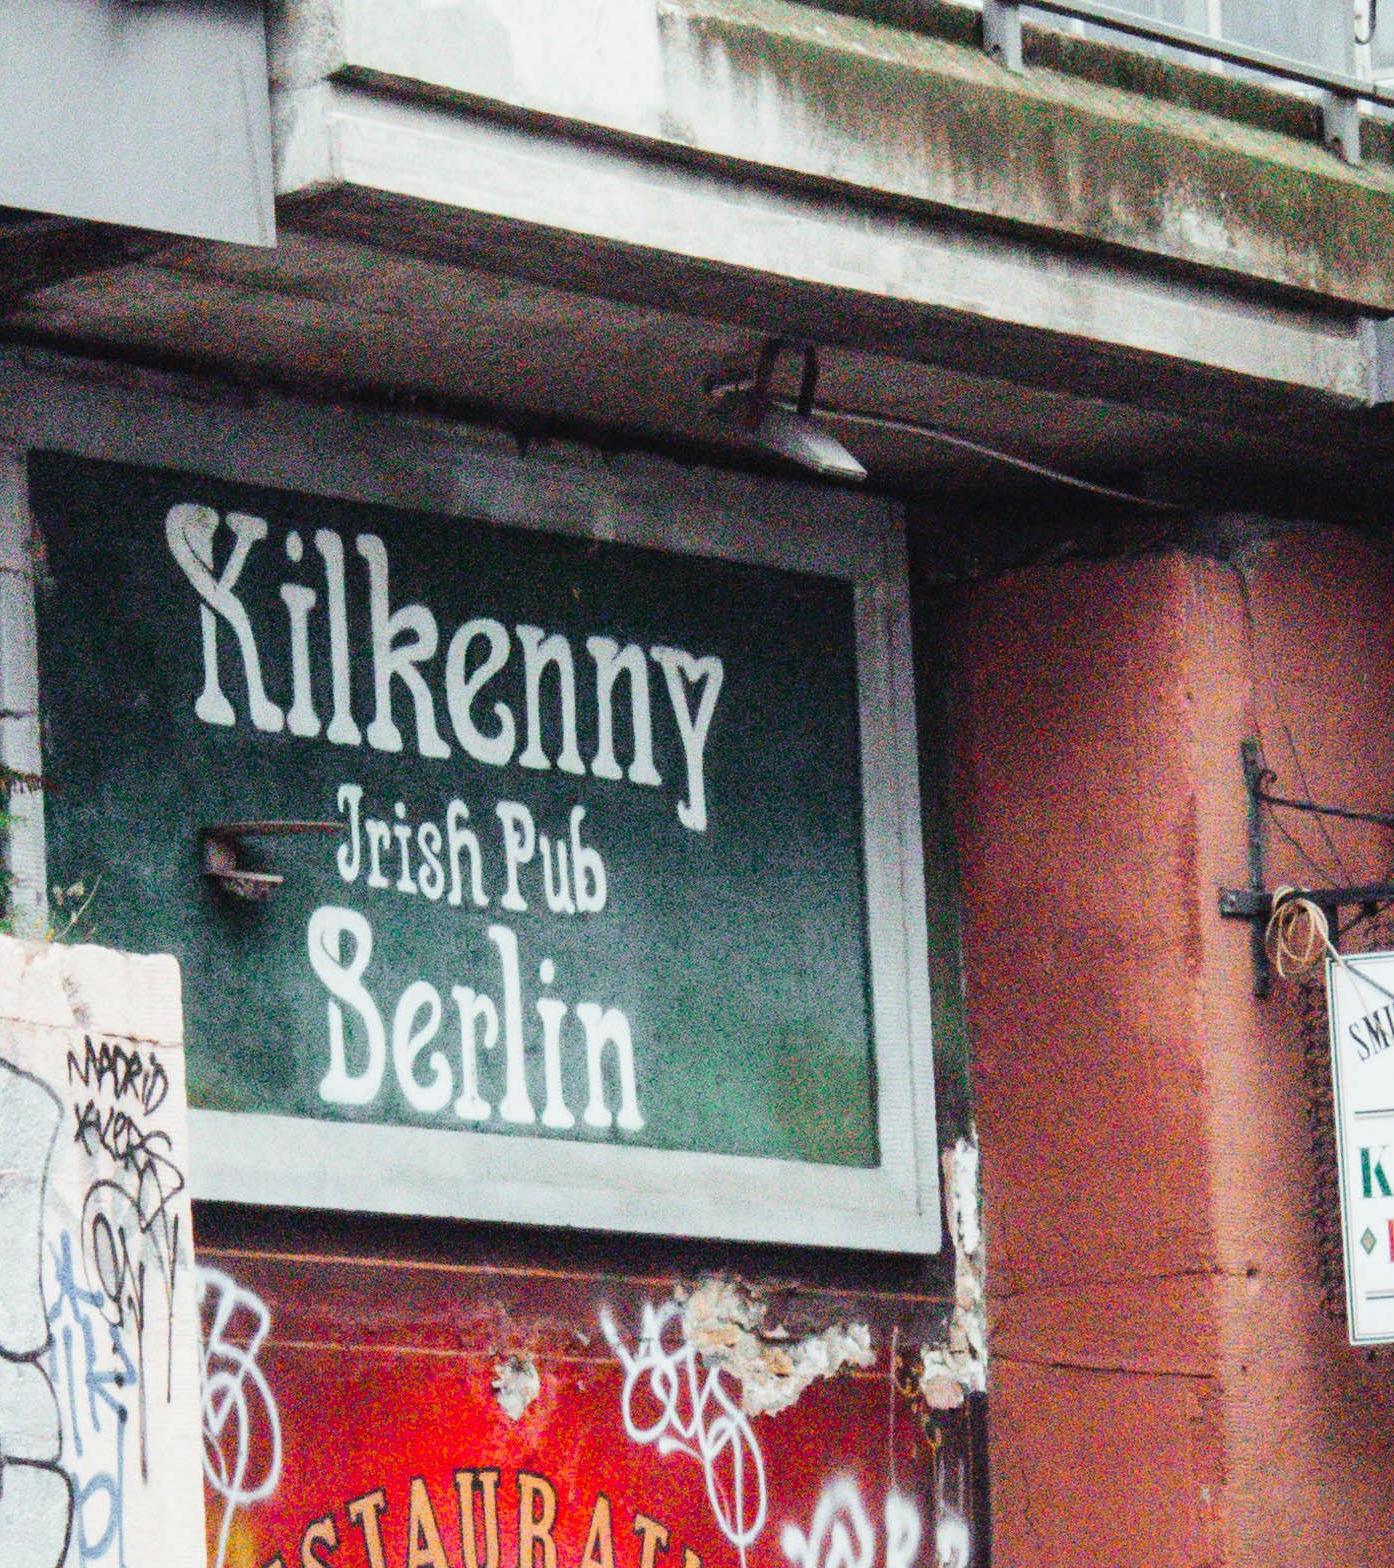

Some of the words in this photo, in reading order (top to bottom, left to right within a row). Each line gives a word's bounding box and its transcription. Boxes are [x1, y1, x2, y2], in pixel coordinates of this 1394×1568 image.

[164, 502, 725, 832] Kilkenny
[336, 783, 489, 906] Irish
[496, 800, 607, 914] Pub
[307, 905, 645, 1131] Berlin
